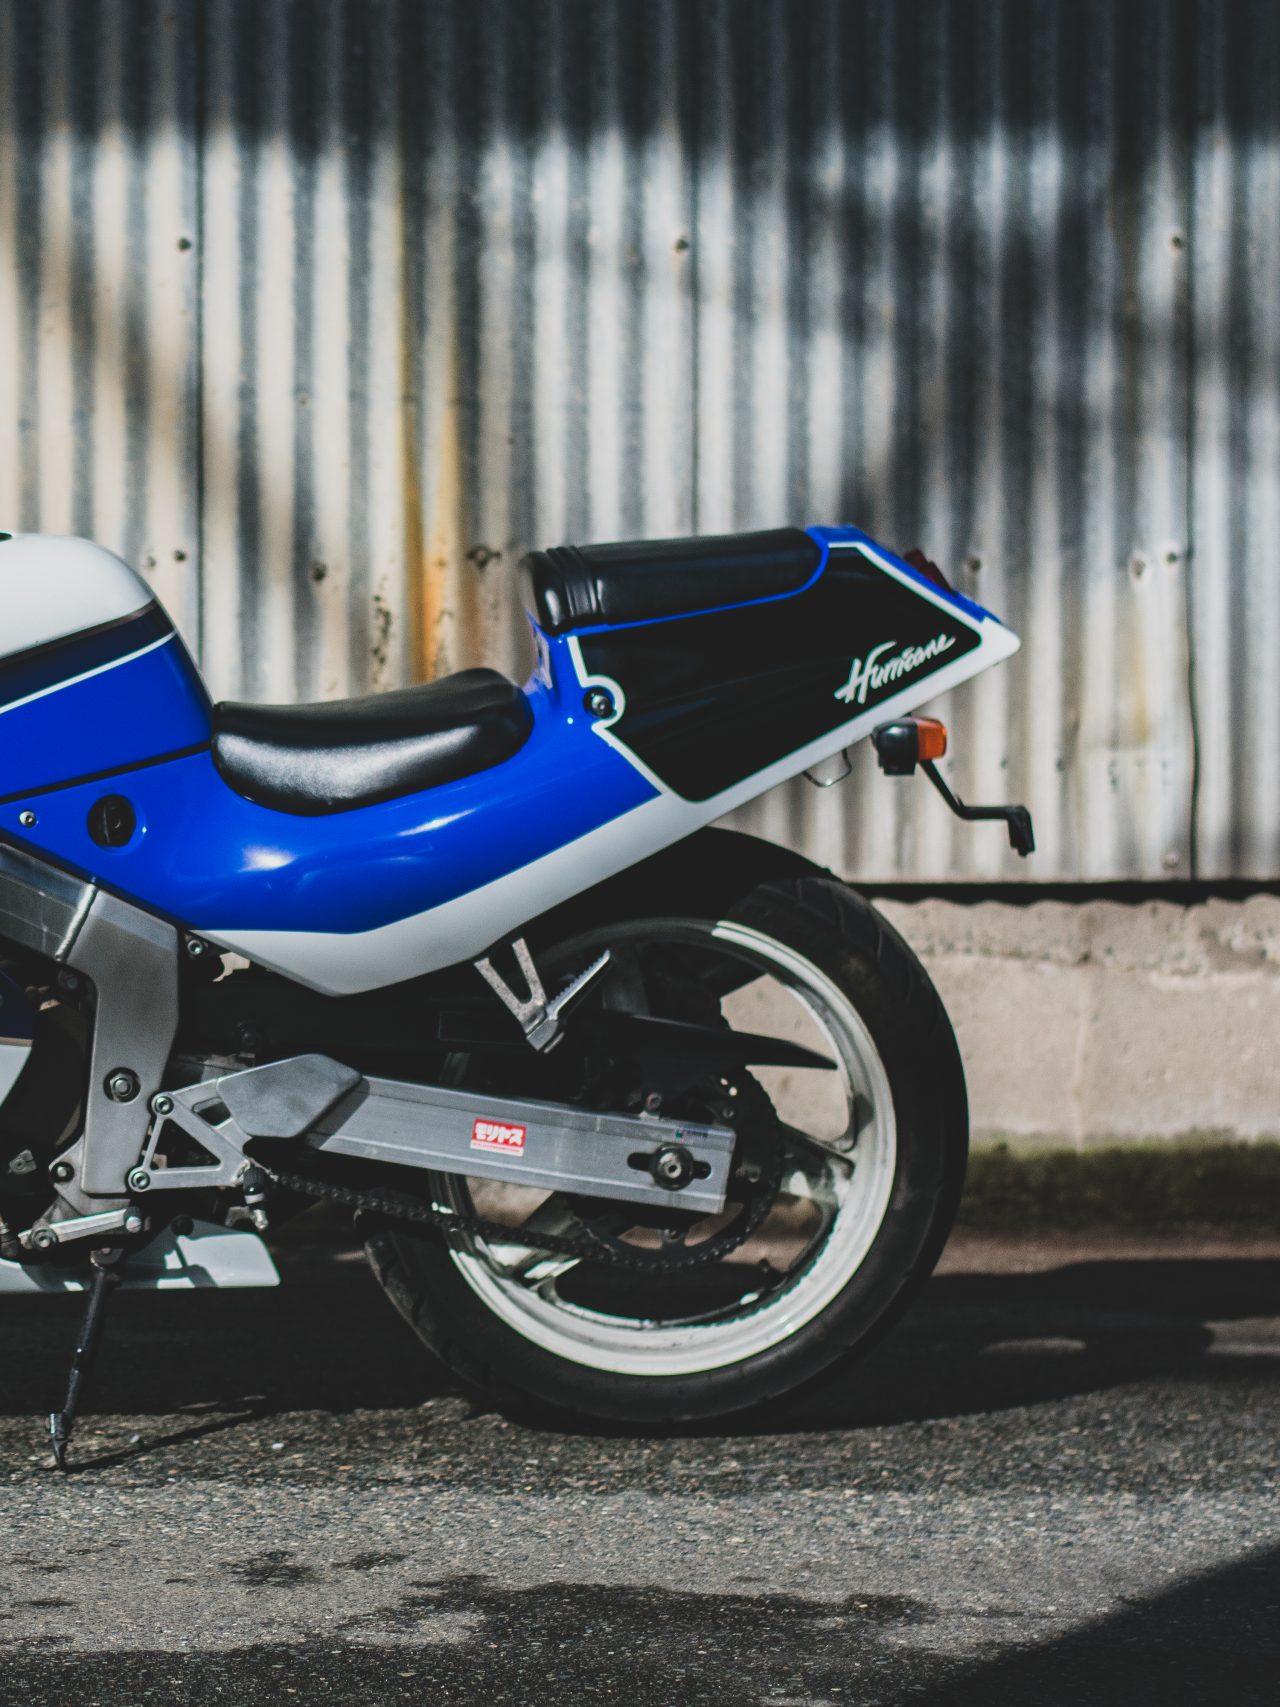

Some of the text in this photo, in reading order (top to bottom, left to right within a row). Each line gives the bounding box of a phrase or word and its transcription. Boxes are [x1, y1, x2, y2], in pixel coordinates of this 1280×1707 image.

[834, 633, 956, 704] Hurricane
[474, 1122, 524, 1146] モリヤス
